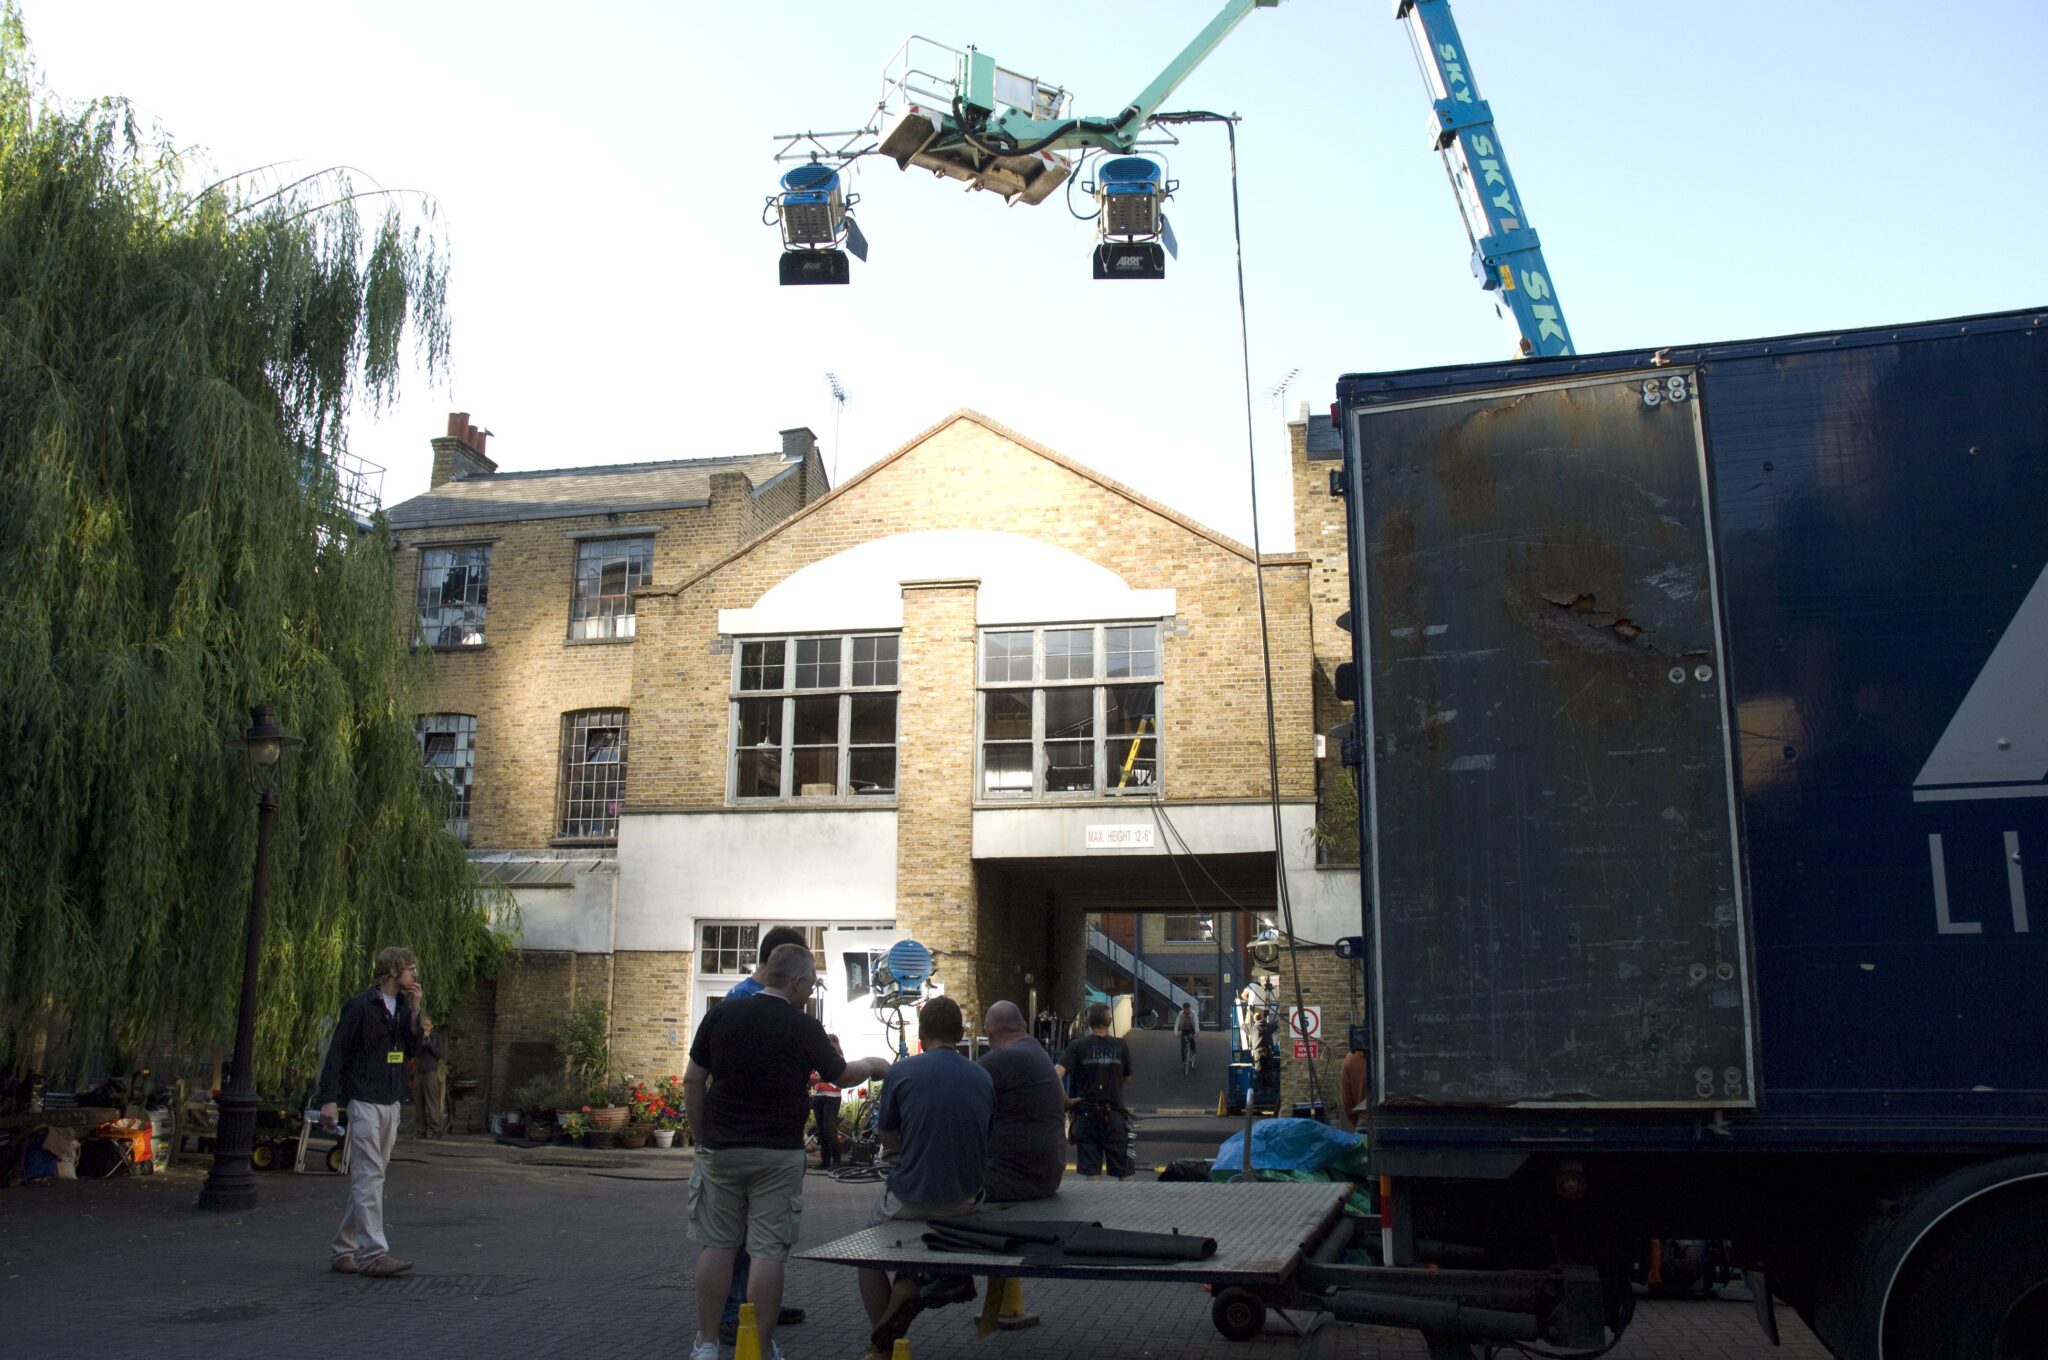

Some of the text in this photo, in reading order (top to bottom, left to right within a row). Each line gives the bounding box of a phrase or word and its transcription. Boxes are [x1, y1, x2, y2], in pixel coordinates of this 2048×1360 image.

[1438, 43, 1472, 104] SKY
[1471, 133, 1520, 234] SKYL
[1116, 256, 1141, 265] ARRI
[1521, 269, 1570, 356] SK
[1088, 830, 1105, 843] MAX.
[1107, 829, 1132, 842] HEIGHT
